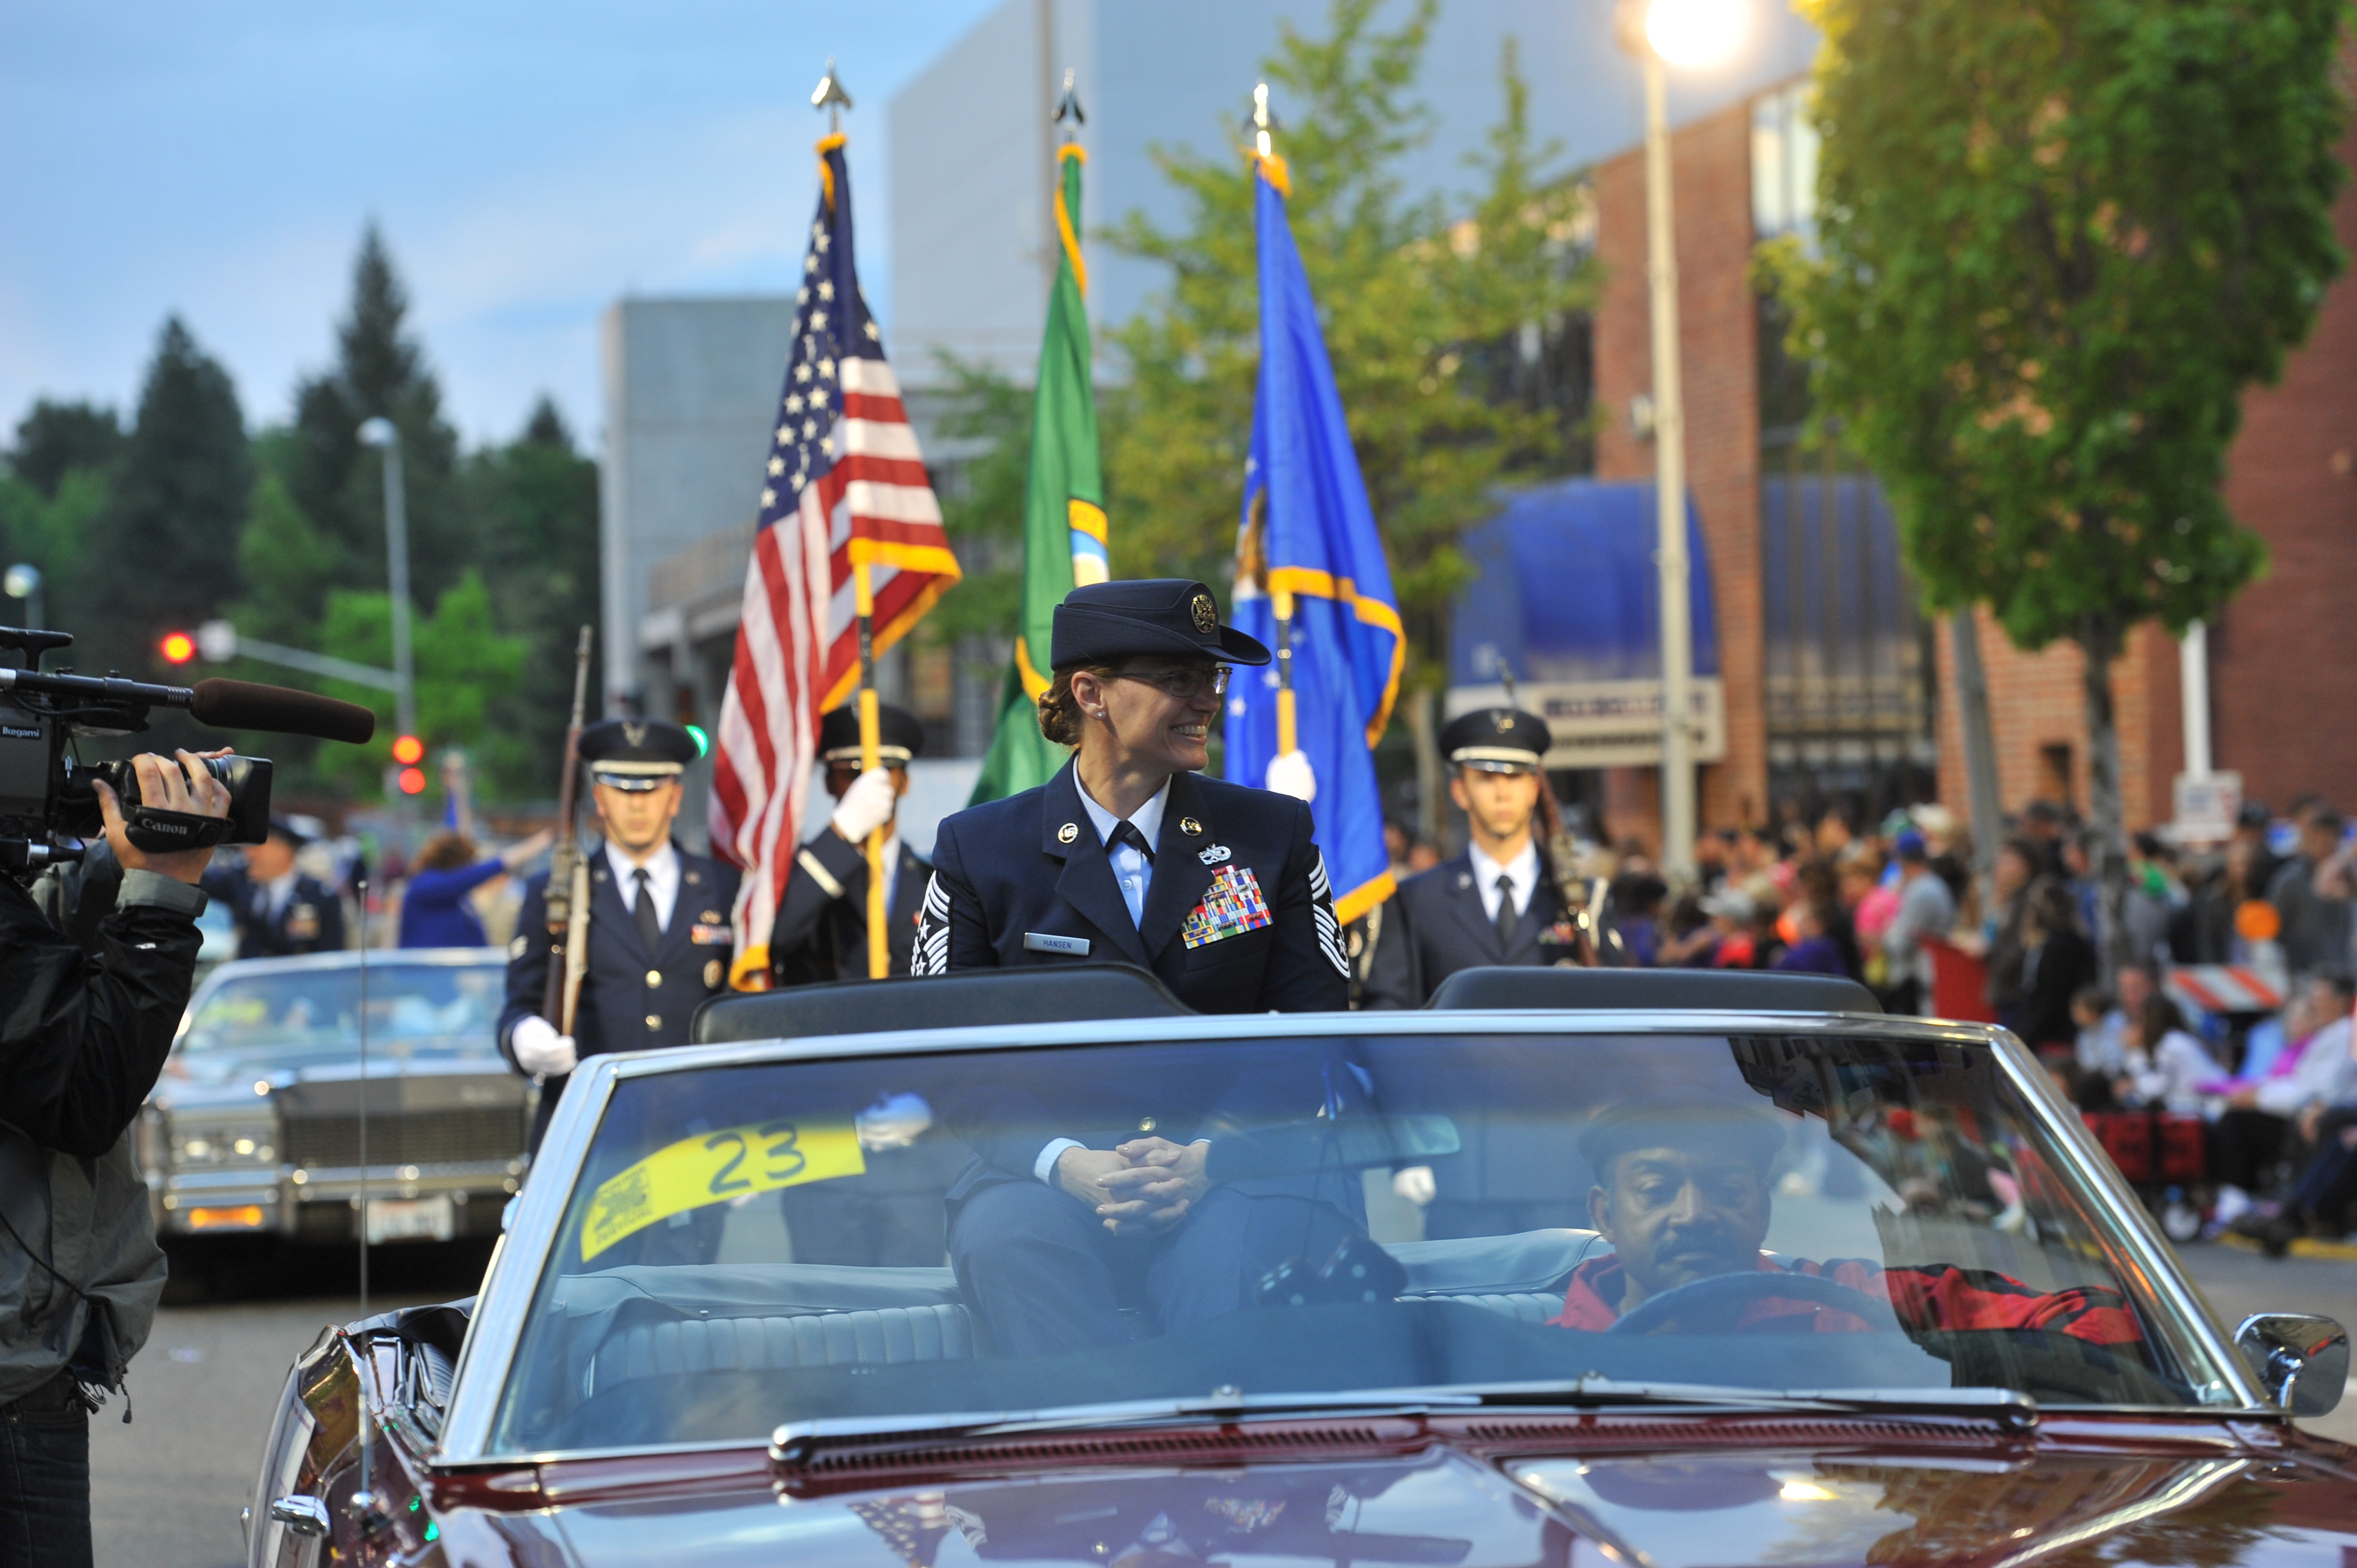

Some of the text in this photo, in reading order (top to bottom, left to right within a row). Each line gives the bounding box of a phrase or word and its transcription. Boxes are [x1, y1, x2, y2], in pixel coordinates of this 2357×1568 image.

[3, 726, 39, 738] Ikegami
[141, 818, 187, 835] Canon
[1043, 940, 1072, 949] HANSEN
[704, 1121, 806, 1196] 23
